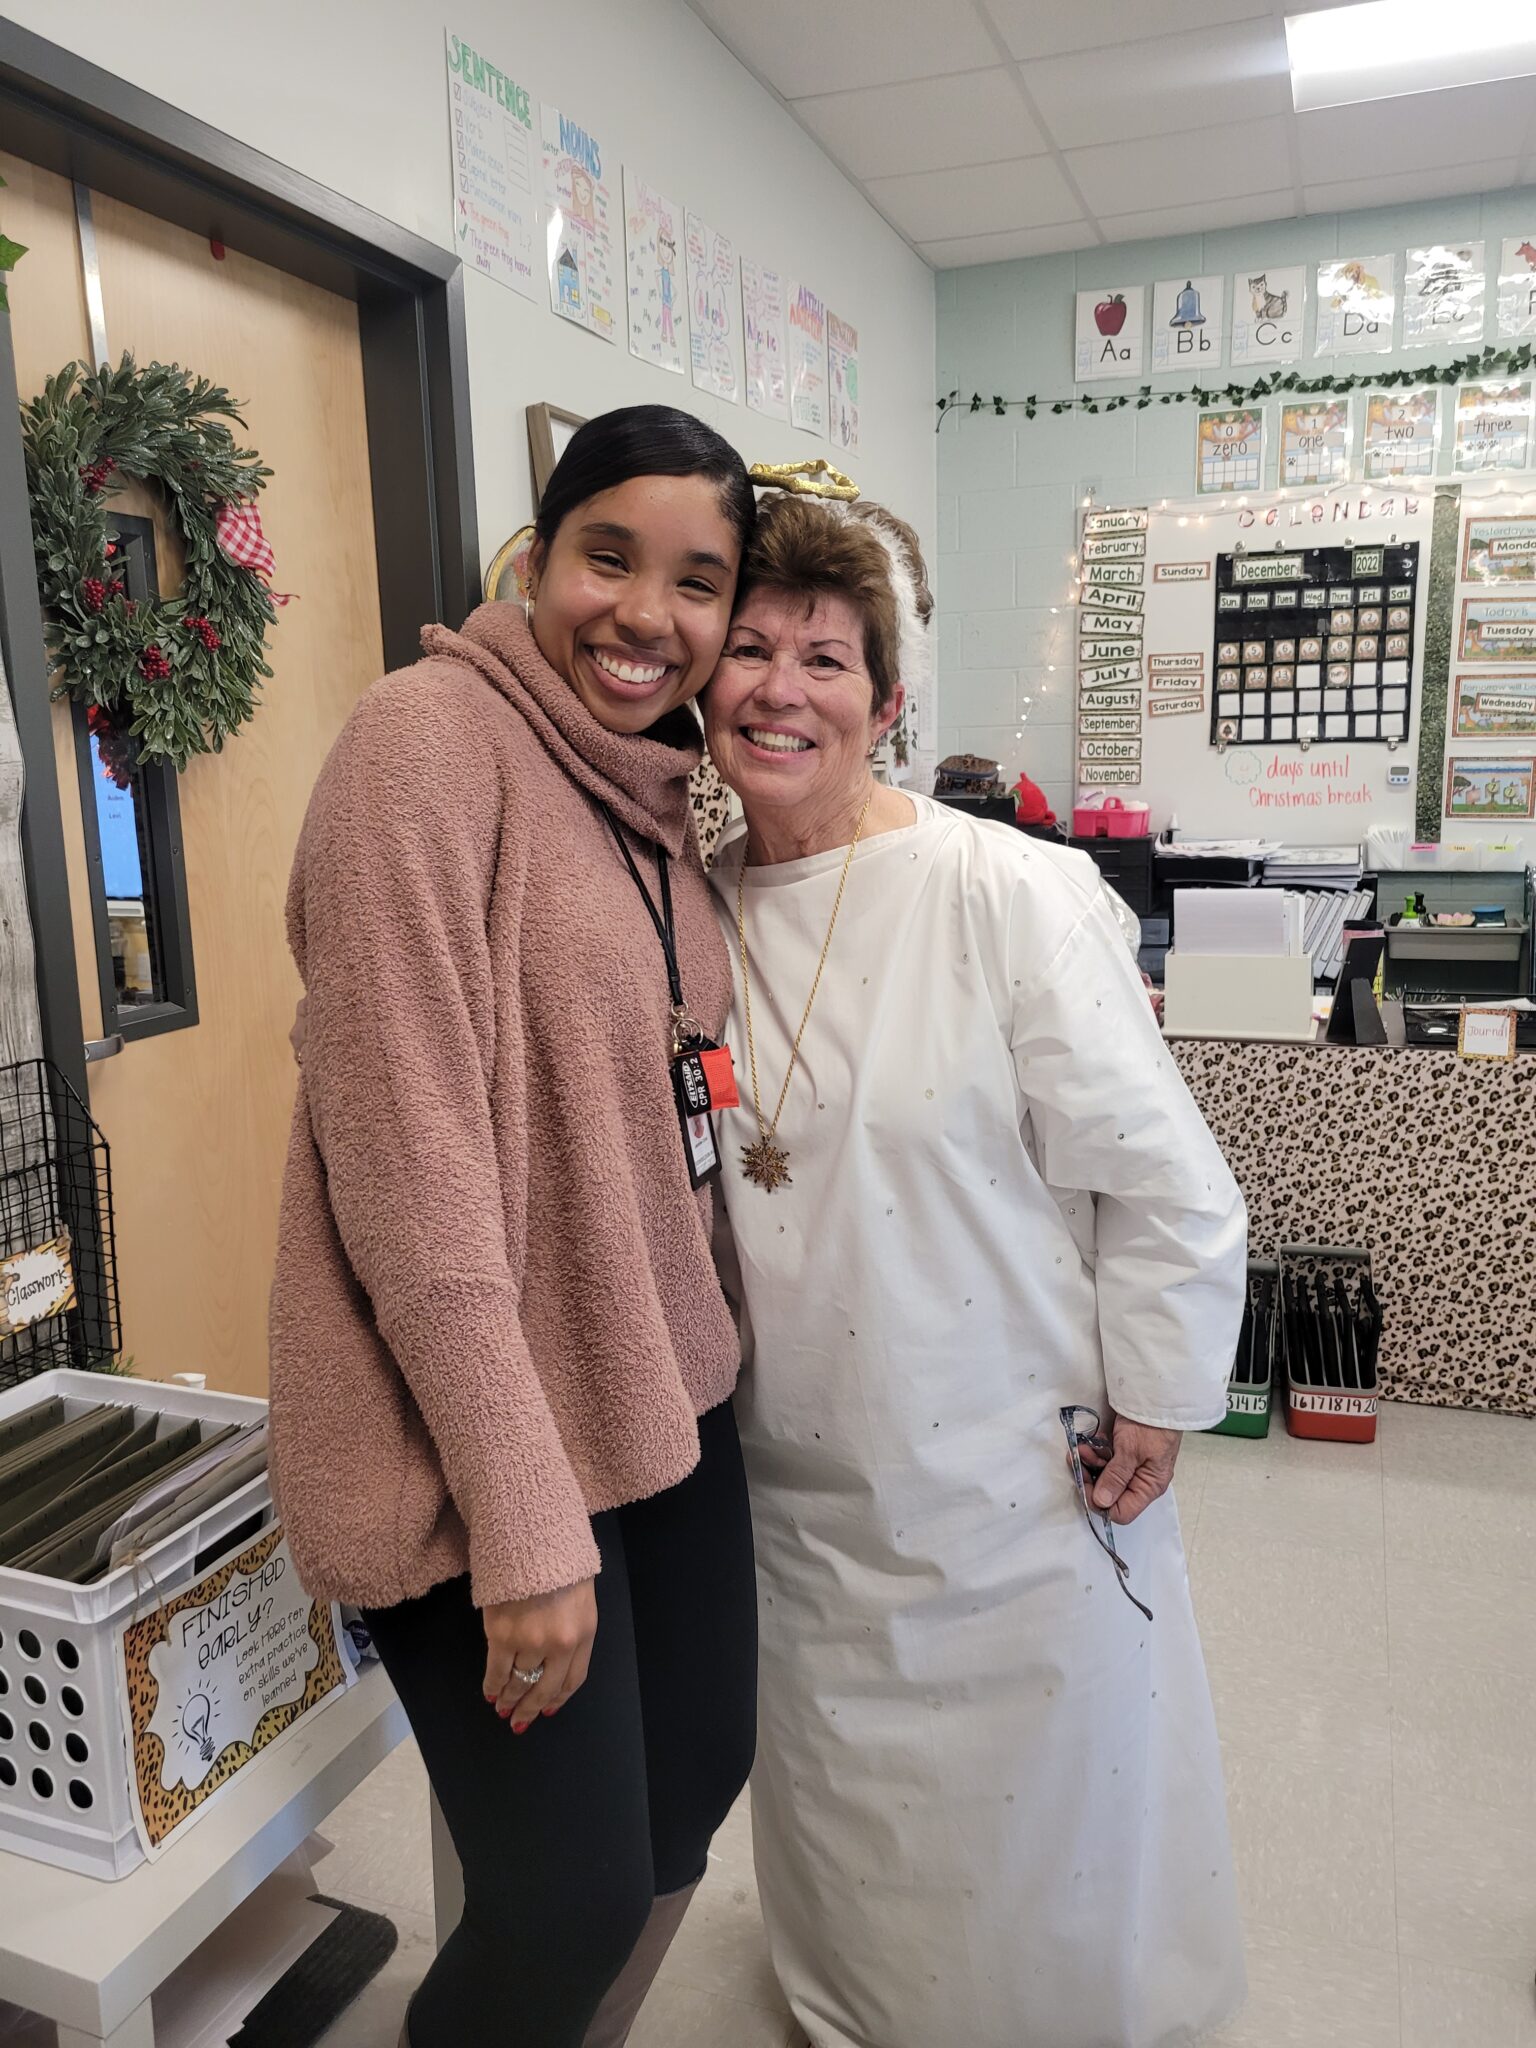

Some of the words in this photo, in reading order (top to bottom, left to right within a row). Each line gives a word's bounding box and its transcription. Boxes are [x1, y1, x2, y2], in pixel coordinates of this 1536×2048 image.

[448, 34, 532, 130] SENTENCE
[559, 113, 601, 180] NOUNS
[1255, 322, 1293, 346] Cc
[1177, 329, 1211, 354] Bb
[1100, 339, 1131, 362] Aa
[1398, 410, 1405, 420] 2
[1226, 426, 1233, 436] 0
[1312, 419, 1317, 430] 1
[1474, 419, 1512, 434] three
[1384, 426, 1414, 440] two
[1213, 441, 1247, 456] zero
[1299, 434, 1325, 449] one
[1474, 527, 1524, 538] Yesterday
[1089, 541, 1139, 555] February
[1161, 567, 1203, 576] Sunday
[1241, 561, 1296, 578] December
[1356, 555, 1378, 571] 2022
[1089, 567, 1135, 581] March
[1088, 588, 1136, 607] April
[1367, 613, 1373, 622] 2
[1485, 607, 1520, 619] Today
[1522, 607, 1528, 616] is
[1094, 617, 1133, 632] May
[1486, 627, 1534, 637] Tuesday
[1088, 644, 1135, 658] June
[1307, 643, 1313, 652] 7
[1391, 640, 1402, 648] 10
[1153, 657, 1199, 667] Thursday
[1091, 667, 1131, 682] July
[1224, 674, 1234, 682] 11
[1251, 671, 1263, 680] 12
[1277, 671, 1288, 679] 13
[1156, 678, 1197, 687] Friday
[1509, 683, 1522, 692] will
[1086, 693, 1136, 706] August
[1153, 700, 1200, 712] Saturday
[1481, 697, 1533, 711] Wednesday
[1084, 718, 1136, 731] September
[1087, 742, 1134, 756] October
[1085, 767, 1136, 781] November
[1267, 753, 1303, 785] days
[1310, 754, 1350, 779] until
[1249, 786, 1322, 808] Christmas
[1327, 784, 1373, 804] break
[1467, 1025, 1508, 1039] Journal
[689, 1057, 703, 1083] 30:2
[697, 1085, 708, 1106] CPR
[7, 1269, 67, 1306] Classwork
[1236, 1394, 1249, 1411] 14
[1253, 1396, 1267, 1410] 15
[1293, 1394, 1307, 1409] 16
[1311, 1396, 1325, 1410] 17
[1329, 1397, 1342, 1412] 18
[1346, 1398, 1361, 1413] 19
[1363, 1398, 1377, 1414] 20
[235, 1640, 260, 1668] Look
[287, 1606, 304, 1625] for
[238, 1657, 265, 1685] extra
[267, 1623, 307, 1666] practice
[243, 1686, 256, 1702] on
[257, 1664, 280, 1690] skills
[282, 1642, 308, 1669] we've
[262, 1669, 297, 1708] learned
